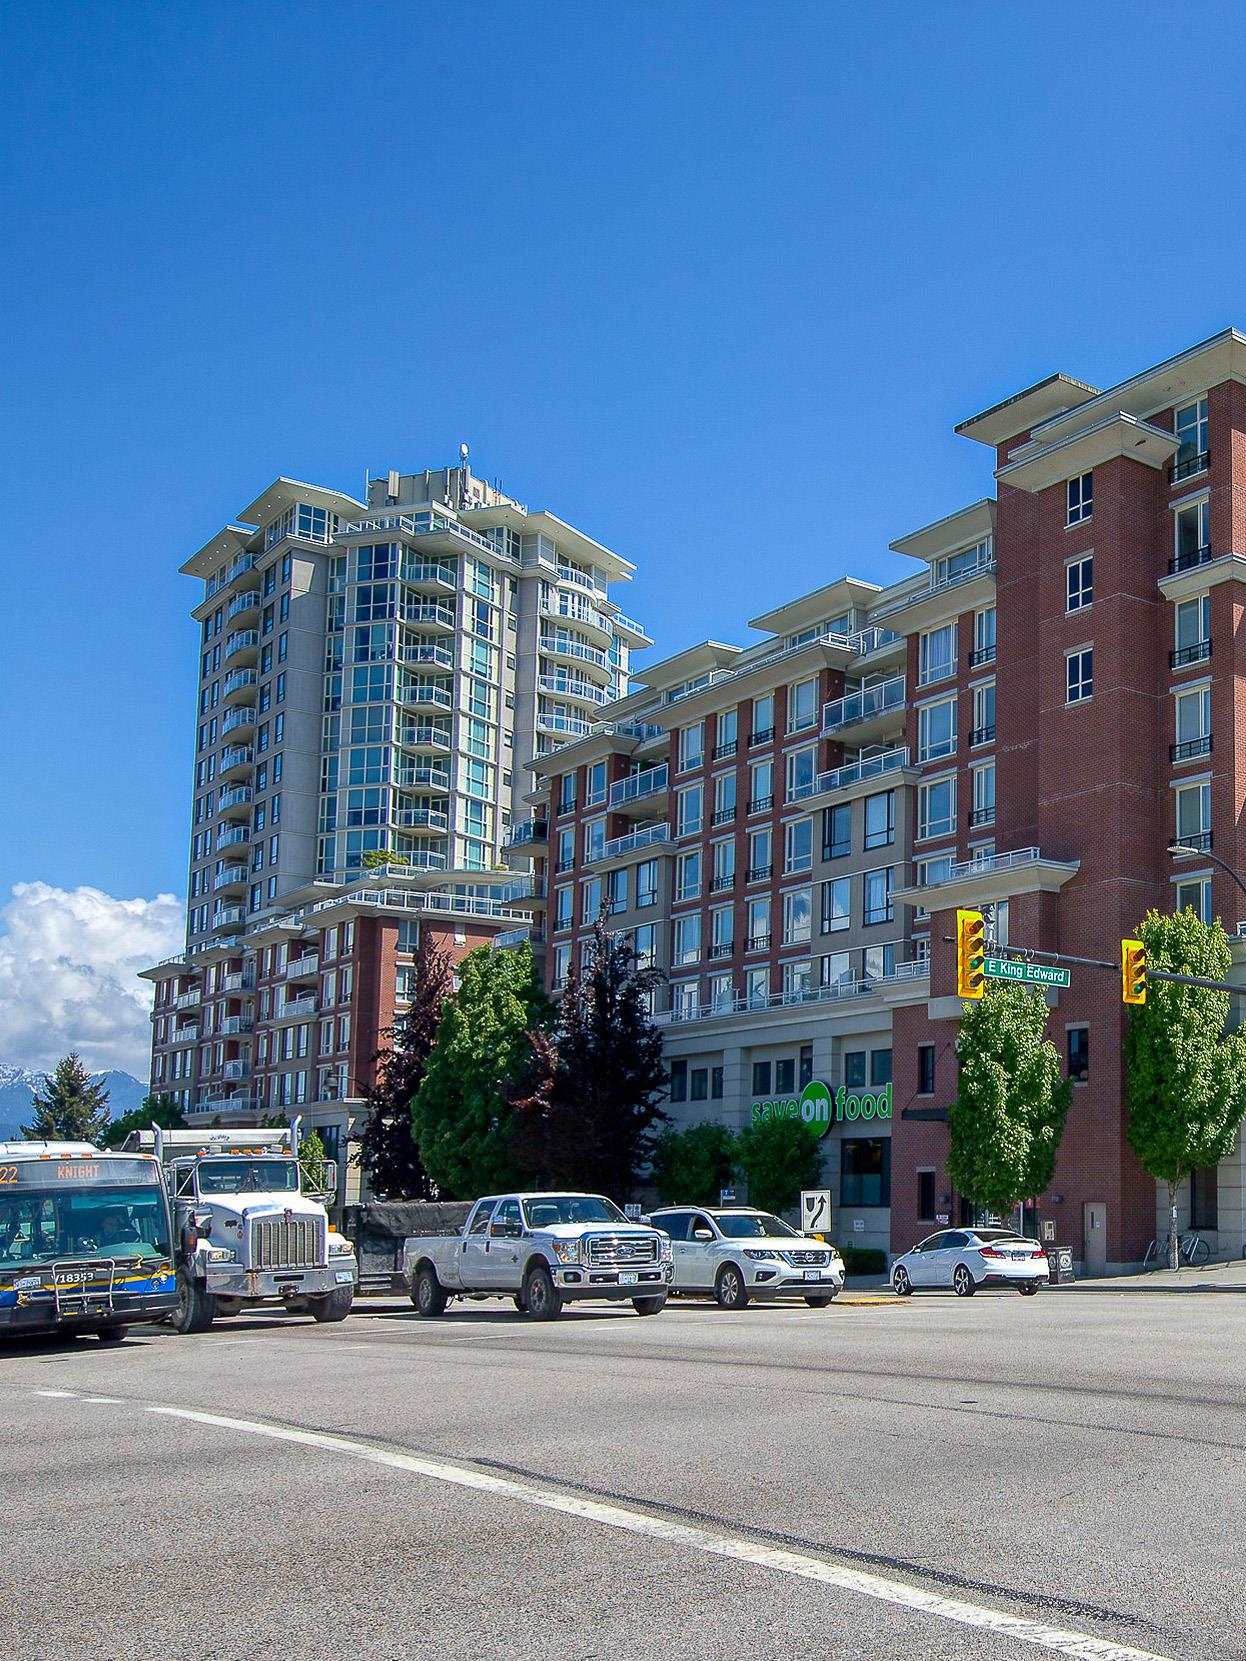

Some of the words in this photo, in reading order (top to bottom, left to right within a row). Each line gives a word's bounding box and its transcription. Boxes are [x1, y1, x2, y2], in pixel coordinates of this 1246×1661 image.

[988, 960, 996, 972] E
[1000, 962, 1023, 978] King
[1026, 965, 1065, 982] Edward
[751, 1099, 799, 1121] save
[801, 1097, 828, 1123] on
[57, 1165, 99, 1179] KNIGHT
